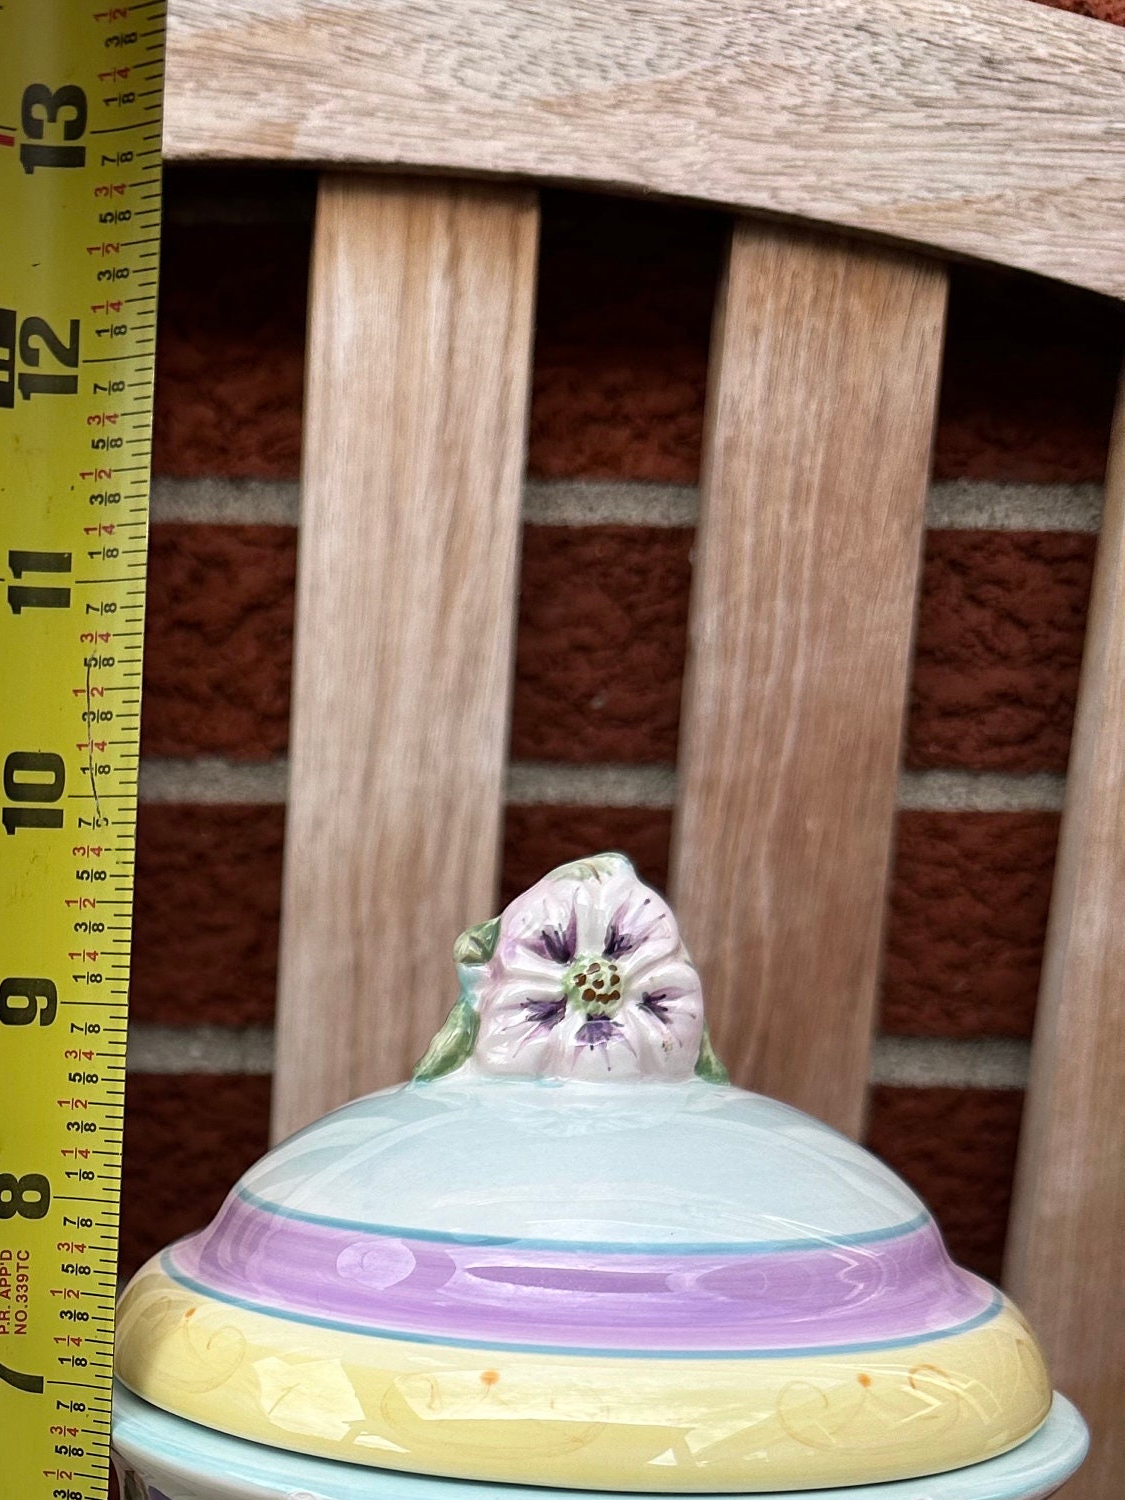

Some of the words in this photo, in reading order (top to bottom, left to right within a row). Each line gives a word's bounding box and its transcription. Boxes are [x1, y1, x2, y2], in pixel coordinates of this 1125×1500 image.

[20, 83, 87, 174] 13
[18, 316, 80, 400] 12
[7, 550, 72, 615] 11
[2, 751, 65, 835] 10
[0, 1249, 13, 1300] APP'D
[14, 1249, 30, 1335] NO.339TC
